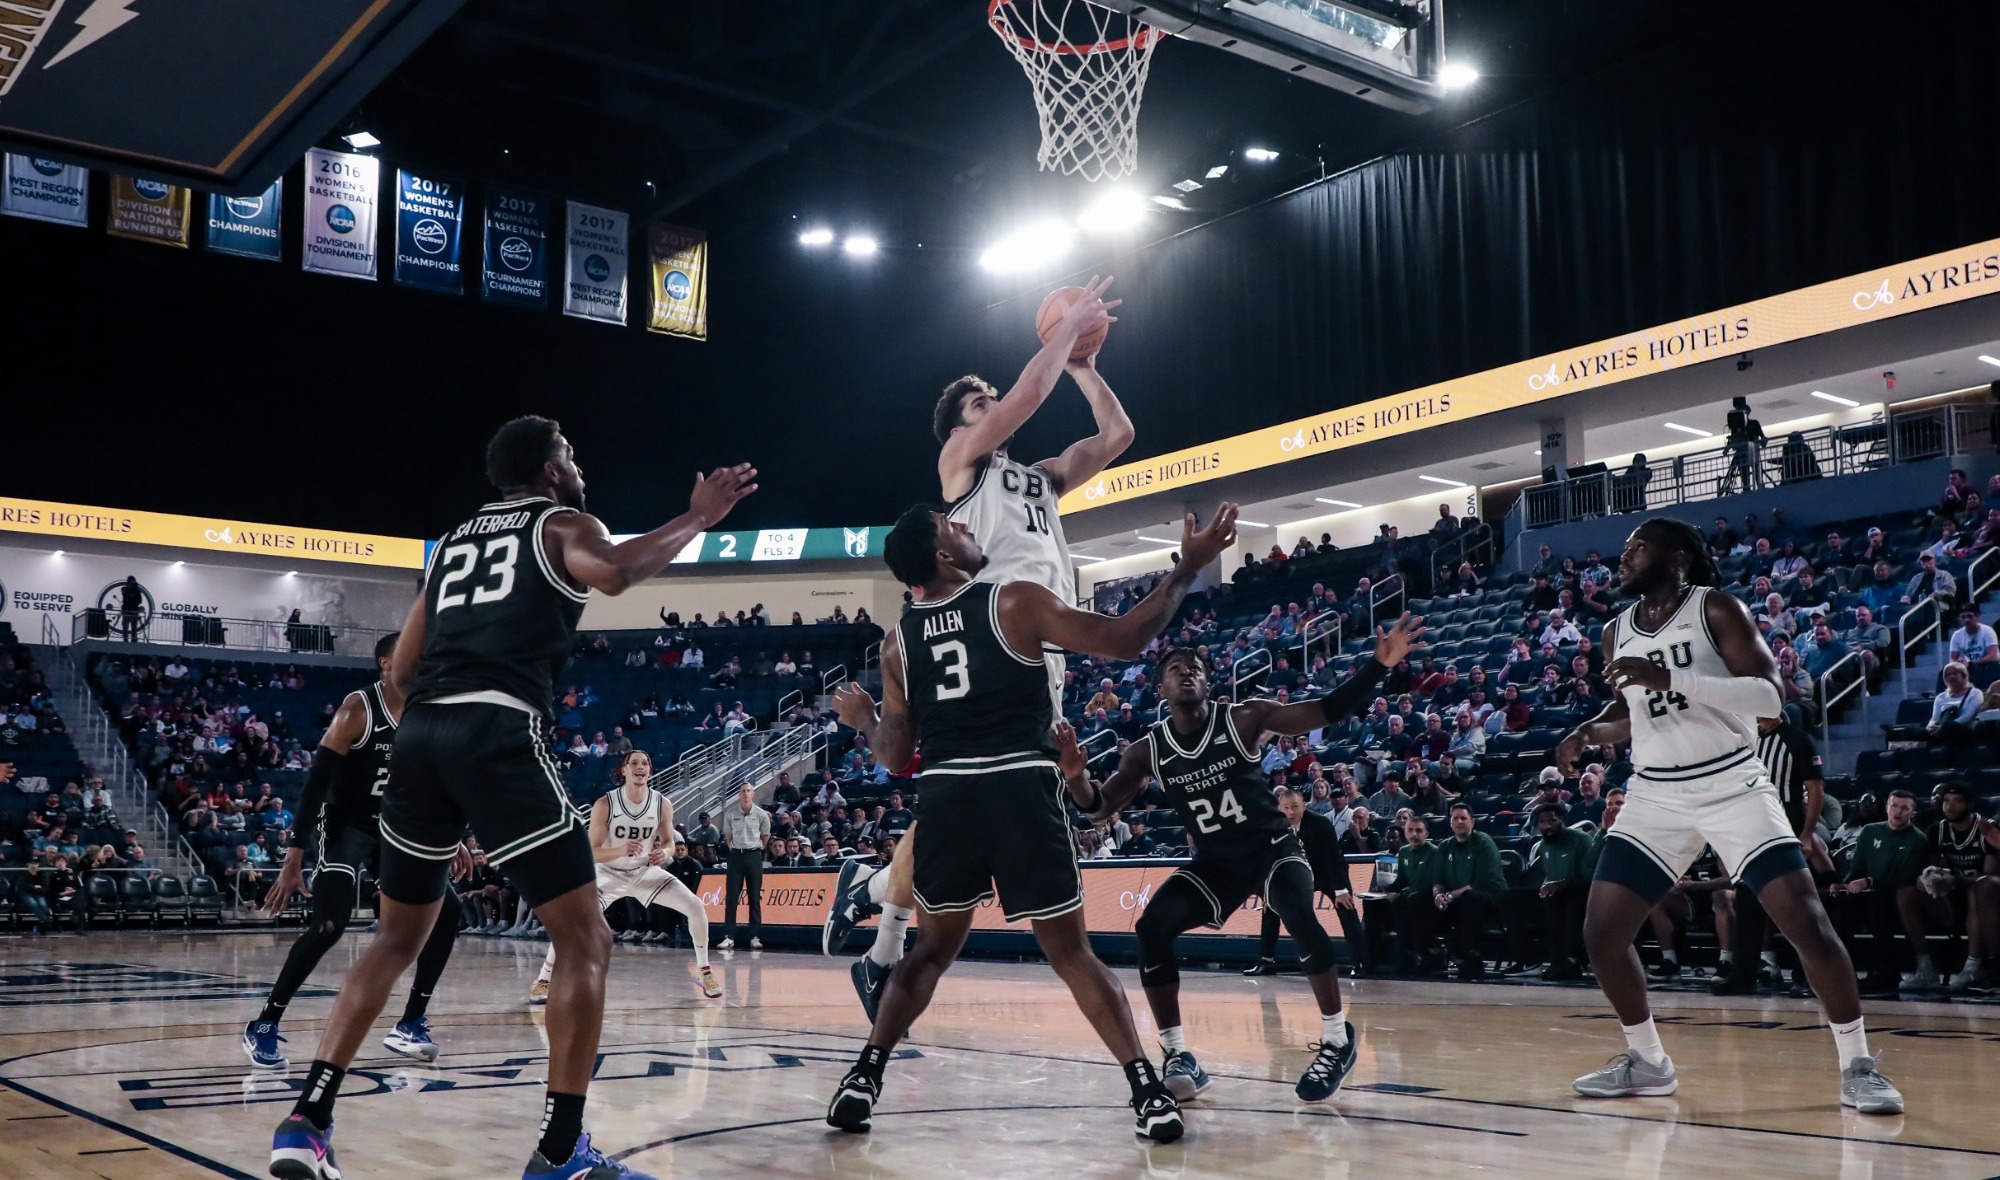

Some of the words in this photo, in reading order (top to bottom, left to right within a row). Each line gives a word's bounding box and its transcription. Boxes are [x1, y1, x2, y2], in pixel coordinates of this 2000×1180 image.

[321, 160, 360, 178] 2016
[9, 176, 39, 189] WEST
[41, 182, 84, 197] REGION
[136, 179, 169, 193] NCAA
[314, 175, 365, 192] WOMEN'S
[411, 176, 451, 196] 2017
[12, 187, 80, 207] CHAMPIONS
[309, 186, 373, 205] BASKETBALL
[404, 190, 454, 208] WOMEN'S
[499, 195, 536, 214] 2017
[118, 200, 171, 216] DIVISION
[400, 201, 462, 221] BASKETBALL
[120, 210, 179, 228] NATIONAL
[209, 218, 277, 238] CHAMPIONS
[329, 217, 355, 229] NCAA
[580, 214, 615, 230] 2017
[114, 219, 164, 236] RUNNER
[167, 228, 184, 239] UP
[316, 236, 357, 250] DIVISION
[570, 237, 625, 256] BASKETBALL
[308, 244, 374, 262] TOURNAMENT
[399, 254, 461, 272] CHAMPIONS
[485, 270, 546, 289] TOURNAMENT
[1900, 254, 2000, 300] AYRES
[489, 280, 541, 297] CHAMPIONS
[569, 282, 592, 293] WEST
[592, 286, 624, 299] REGION
[572, 292, 622, 308] CHAMPIONS
[1563, 346, 1638, 382] AYRES
[1649, 318, 1749, 361] HOTELS
[1308, 415, 1366, 445] AYRES
[1373, 393, 1451, 429] HOTELS
[1107, 469, 1153, 494] AYRES
[1159, 452, 1220, 481] HOTELS
[1002, 468, 1043, 499] CB
[0, 507, 41, 525] RES
[50, 511, 132, 533] HOTELS
[1024, 503, 1049, 536] 10
[236, 531, 295, 549] AYRES
[304, 537, 374, 556] HOTELS
[719, 534, 737, 558] 2
[787, 533, 794, 541] 4
[787, 546, 794, 555] 2
[437, 534, 520, 615] 23
[14, 591, 73, 603] EQUIPPED
[14, 600, 31, 610] TO
[33, 602, 72, 613] SERVE
[161, 602, 218, 614] GLOBALLY
[924, 610, 965, 641] ALLEN
[1646, 641, 1694, 670] BU
[931, 640, 971, 701] 3
[1645, 688, 1690, 718] 24
[1167, 756, 1237, 785] PORTLAND
[1184, 773, 1228, 793] STATE
[1188, 788, 1248, 834] 24
[615, 825, 654, 839] CBU
[766, 888, 826, 907] HOTELS
